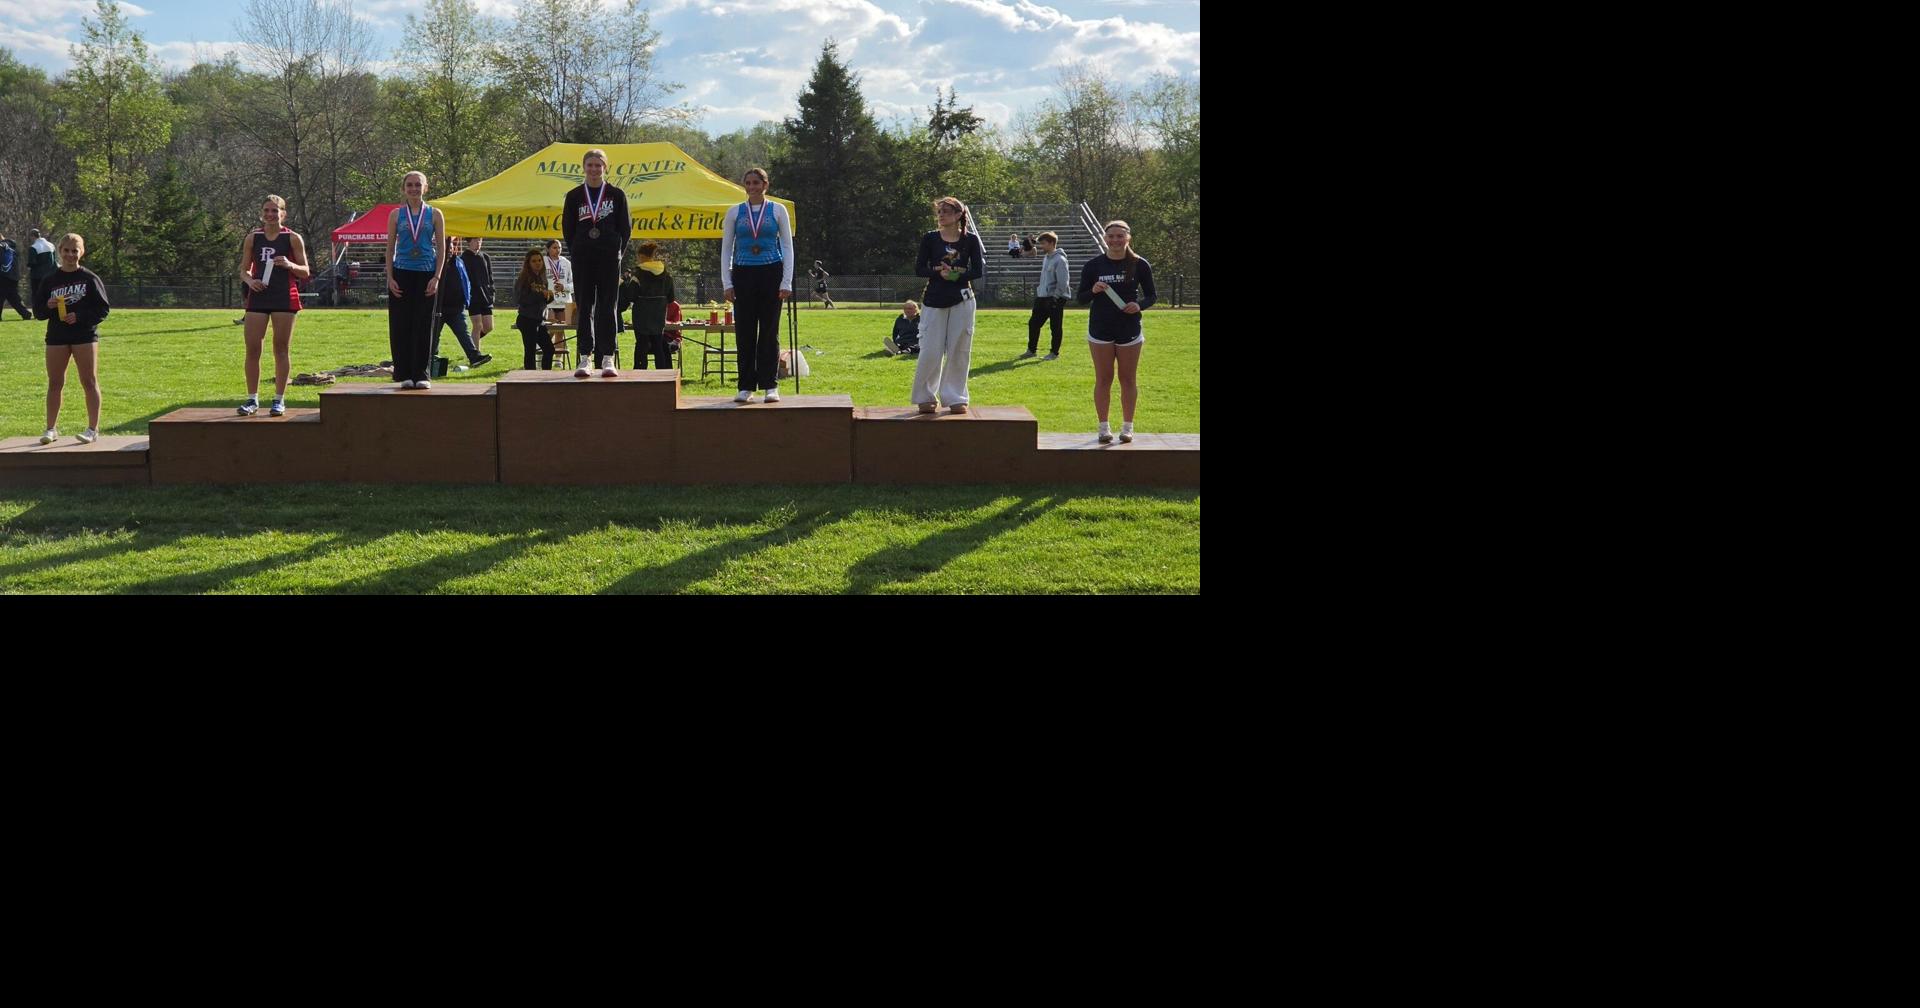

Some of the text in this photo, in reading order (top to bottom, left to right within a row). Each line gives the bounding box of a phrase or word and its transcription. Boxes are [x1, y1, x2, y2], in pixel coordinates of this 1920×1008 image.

[536, 160, 687, 175] MARN CENTER
[485, 213, 549, 232] MARION
[631, 212, 668, 231] rack
[671, 212, 684, 231] &
[338, 233, 375, 241] PURCHASE
